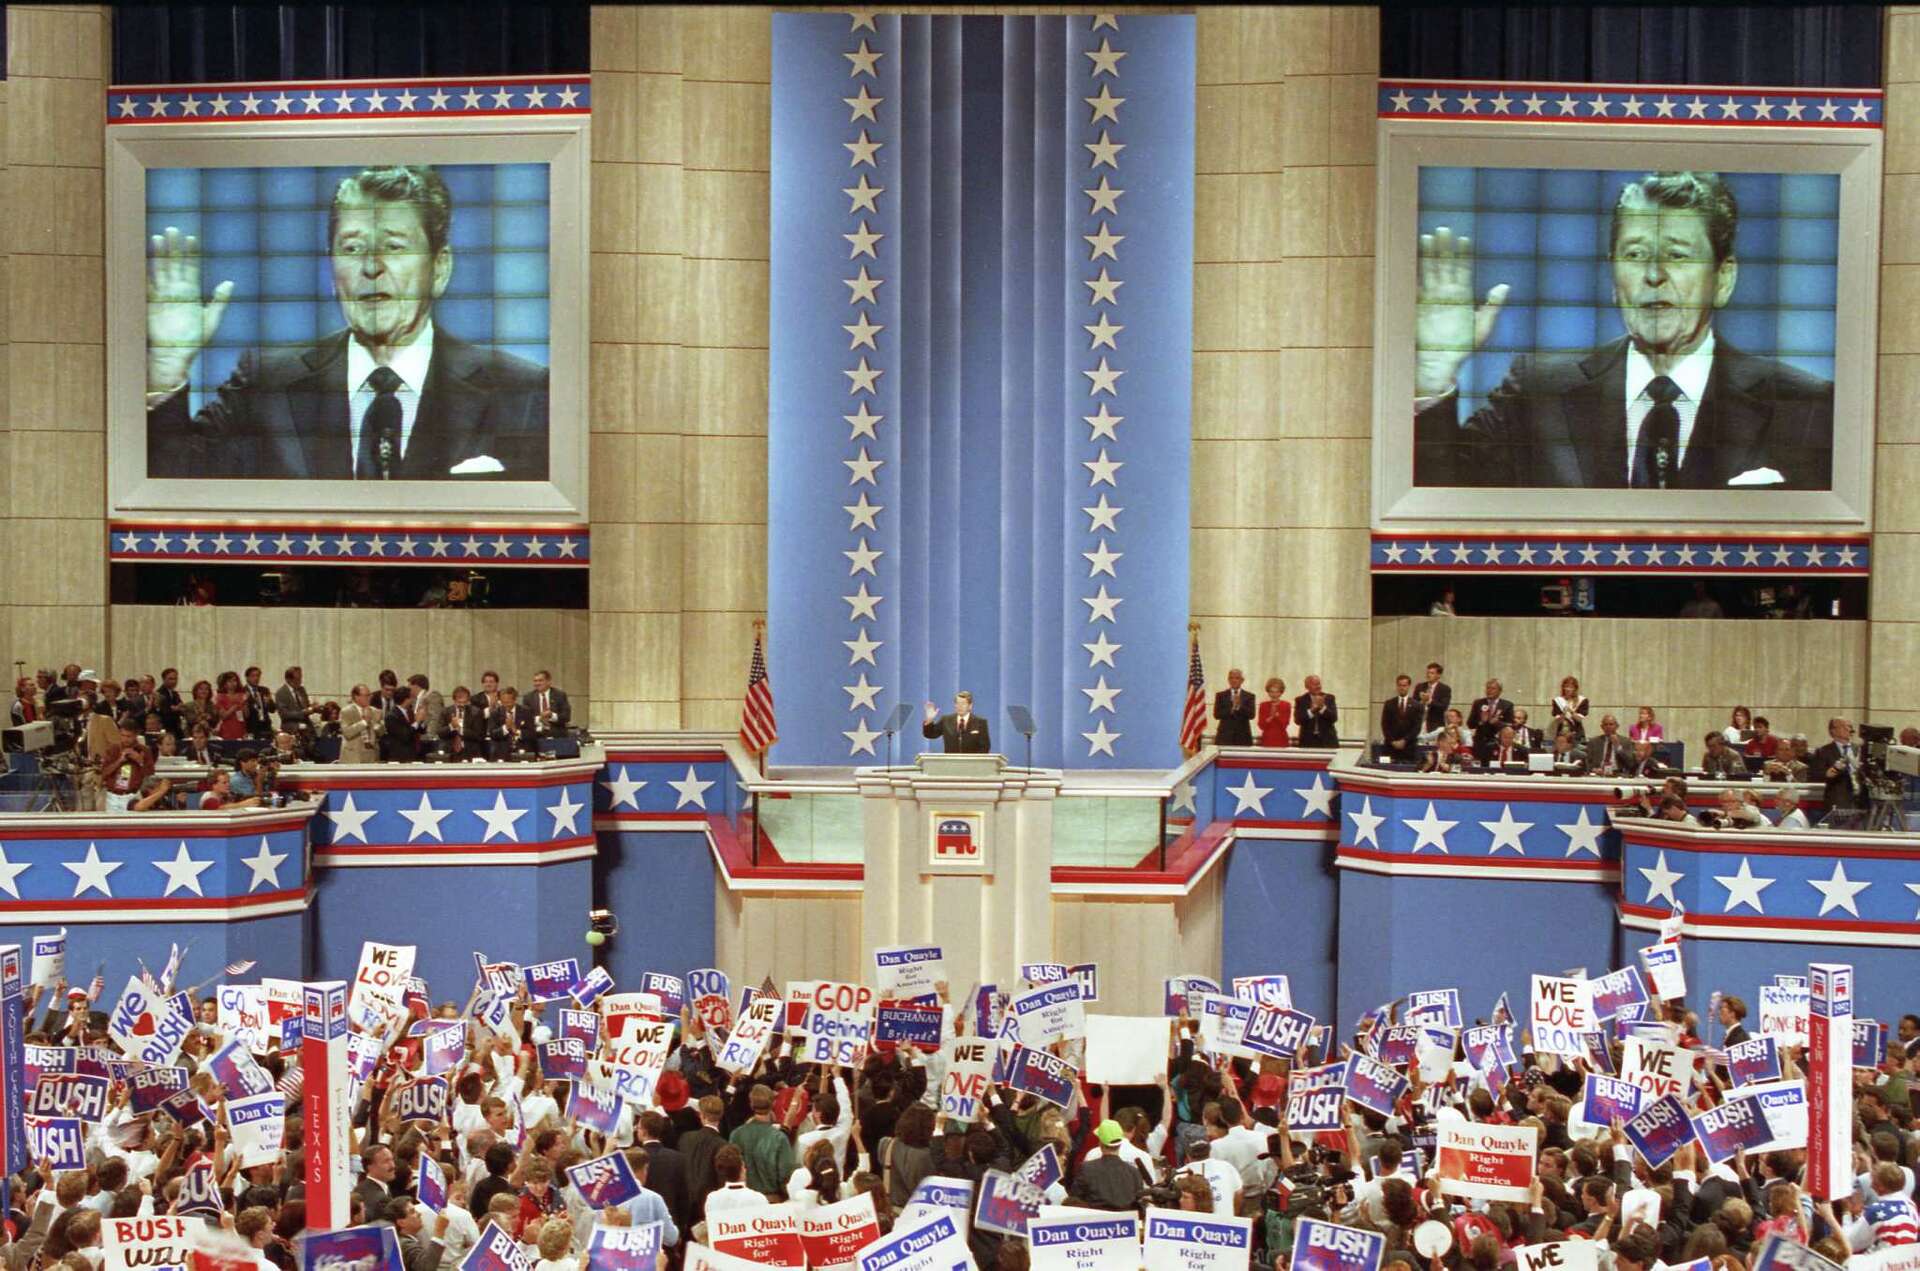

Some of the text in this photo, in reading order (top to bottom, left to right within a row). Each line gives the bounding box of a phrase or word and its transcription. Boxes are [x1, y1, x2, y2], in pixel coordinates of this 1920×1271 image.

[372, 947, 398, 968] WE
[880, 951, 938, 965] Dan Quayle
[533, 963, 570, 981] BUSH
[1030, 966, 1063, 981] BUSH
[650, 976, 682, 994] BUSH
[792, 990, 811, 999] Dan
[1539, 980, 1577, 1003] WE
[1593, 972, 1632, 996] BUSH
[222, 990, 244, 1012] GO
[610, 1002, 631, 1012] Dan
[815, 983, 871, 1012] GOP
[1019, 998, 1042, 1014] Dan
[1044, 986, 1078, 1005] Quayle
[1416, 992, 1449, 1006] BUSH
[112, 992, 147, 1037] We
[567, 1012, 596, 1029] BUSH
[750, 1004, 774, 1022] WE
[882, 1011, 940, 1024] BUCHANAN
[1535, 1003, 1585, 1028] LOVE
[636, 1026, 665, 1044] WE
[813, 1014, 869, 1040] Behind
[1250, 1012, 1306, 1049] BUSH
[1469, 1027, 1500, 1047] BUSH
[142, 1013, 189, 1065] BUSH
[432, 1026, 464, 1051] BUSH
[546, 1040, 585, 1058] BUSH
[1539, 1028, 1582, 1052] RON
[25, 1048, 66, 1067] BUSH
[619, 1047, 666, 1069] LOVE
[816, 1037, 865, 1063] BUSH
[954, 1045, 986, 1062] WE
[1638, 1044, 1675, 1077] WE
[1731, 1041, 1768, 1063] BUSH
[136, 1070, 181, 1089] BUSH
[1355, 1059, 1400, 1089] BUSH
[944, 1072, 986, 1100] OVE
[1595, 1079, 1636, 1104] BUSH
[38, 1082, 103, 1116] BUSH
[404, 1085, 447, 1114] BUSH
[945, 1097, 976, 1117] ON
[1288, 1094, 1340, 1125] BUSH
[1760, 1090, 1800, 1108] Quayle
[235, 1109, 261, 1123] Dan
[1633, 1101, 1677, 1138] BUSH
[1703, 1101, 1754, 1134] BUSH
[27, 1126, 80, 1163] USH
[311, 1095, 324, 1183] TEXAS
[1448, 1131, 1475, 1146] Dan
[1481, 1135, 1529, 1152] Quayle
[1470, 1152, 1504, 1165] Right
[1477, 1163, 1495, 1174] for
[575, 1157, 620, 1183] BUSH
[1461, 1173, 1511, 1186] America
[718, 1222, 747, 1235] Dan
[803, 1219, 833, 1233] Dan
[1037, 1224, 1129, 1243] Dan Quayle
[1155, 1223, 1243, 1245] Dan Quayle
[602, 1228, 655, 1249] BUSH
[743, 1237, 778, 1249] Right
[829, 1232, 864, 1246] Right
[838, 1244, 857, 1253] for
[867, 1224, 950, 1269] Dan Quayle
[1309, 1224, 1370, 1257] BUSH
[752, 1249, 771, 1259] for
[1066, 1247, 1103, 1259] Right
[1179, 1248, 1216, 1260] Right
[1525, 1243, 1564, 1271] WE
[1076, 1260, 1094, 1269] for
[1187, 1261, 1206, 1271] for
